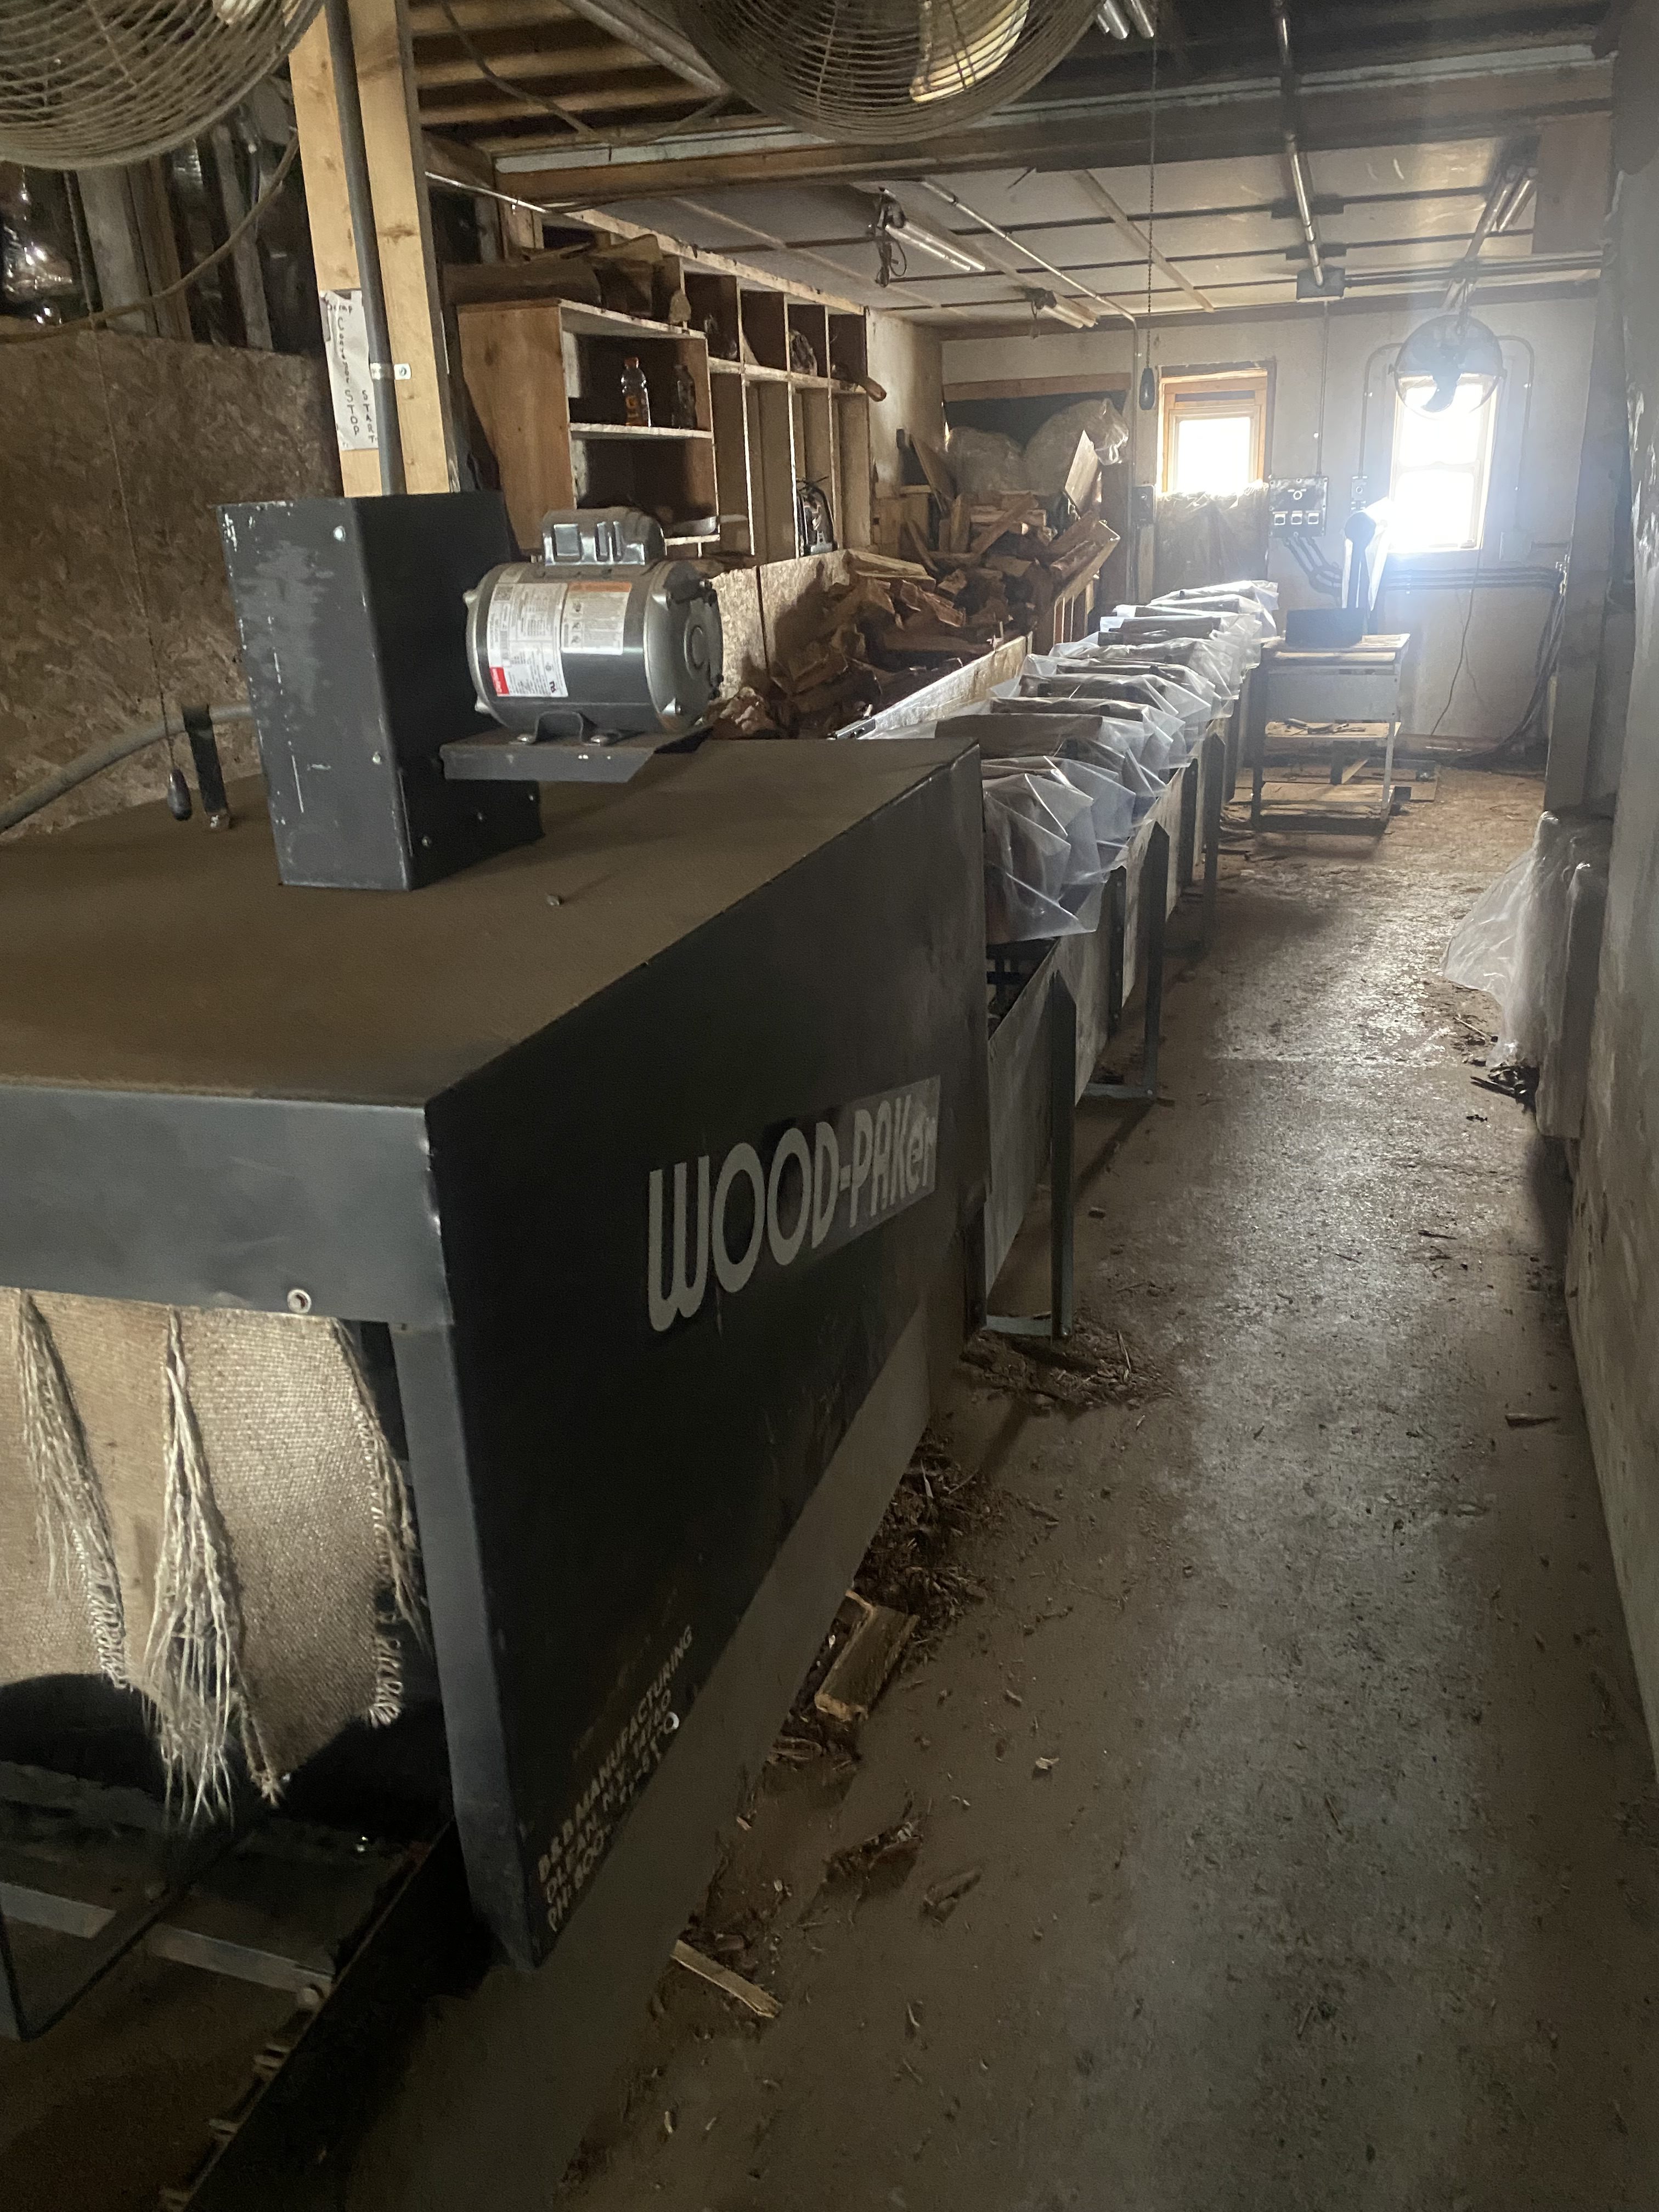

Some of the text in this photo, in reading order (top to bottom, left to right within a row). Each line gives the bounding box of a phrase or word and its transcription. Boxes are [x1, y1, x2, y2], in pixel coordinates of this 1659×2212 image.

[345, 390, 360, 436] STOP
[362, 390, 375, 443] START
[575, 1624, 693, 1830] MANUFACTURING
